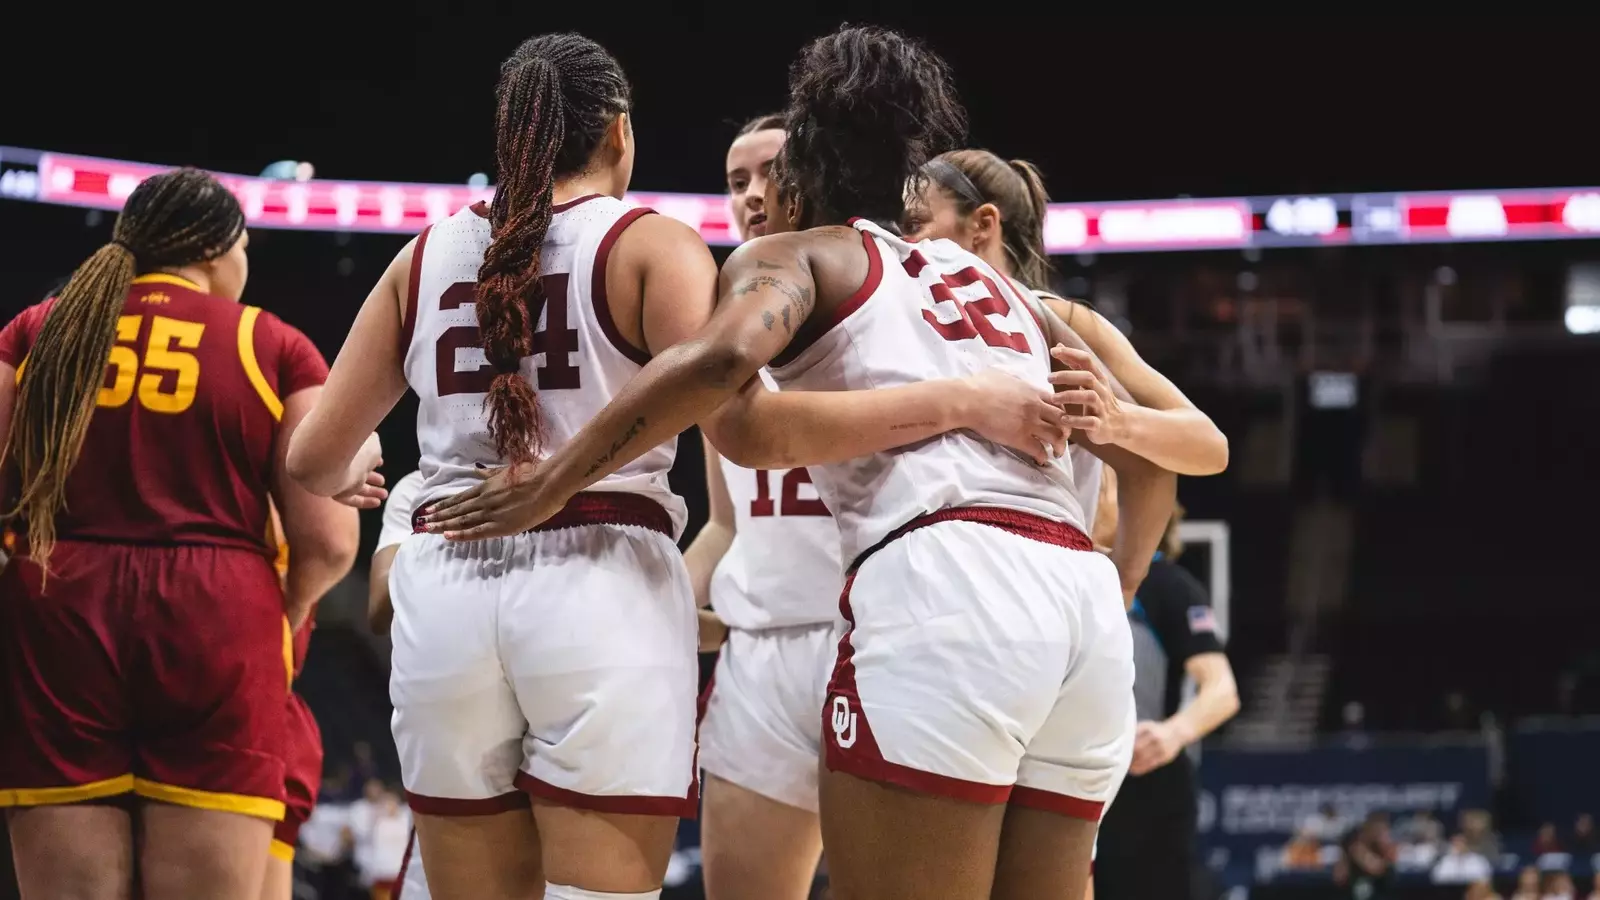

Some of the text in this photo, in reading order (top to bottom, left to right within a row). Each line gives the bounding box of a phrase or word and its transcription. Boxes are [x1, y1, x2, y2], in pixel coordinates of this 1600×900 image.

[436, 273, 580, 397] 24
[901, 249, 1033, 355] 32
[96, 315, 206, 414] 55
[750, 466, 833, 517] 12
[832, 696, 857, 748] OU
